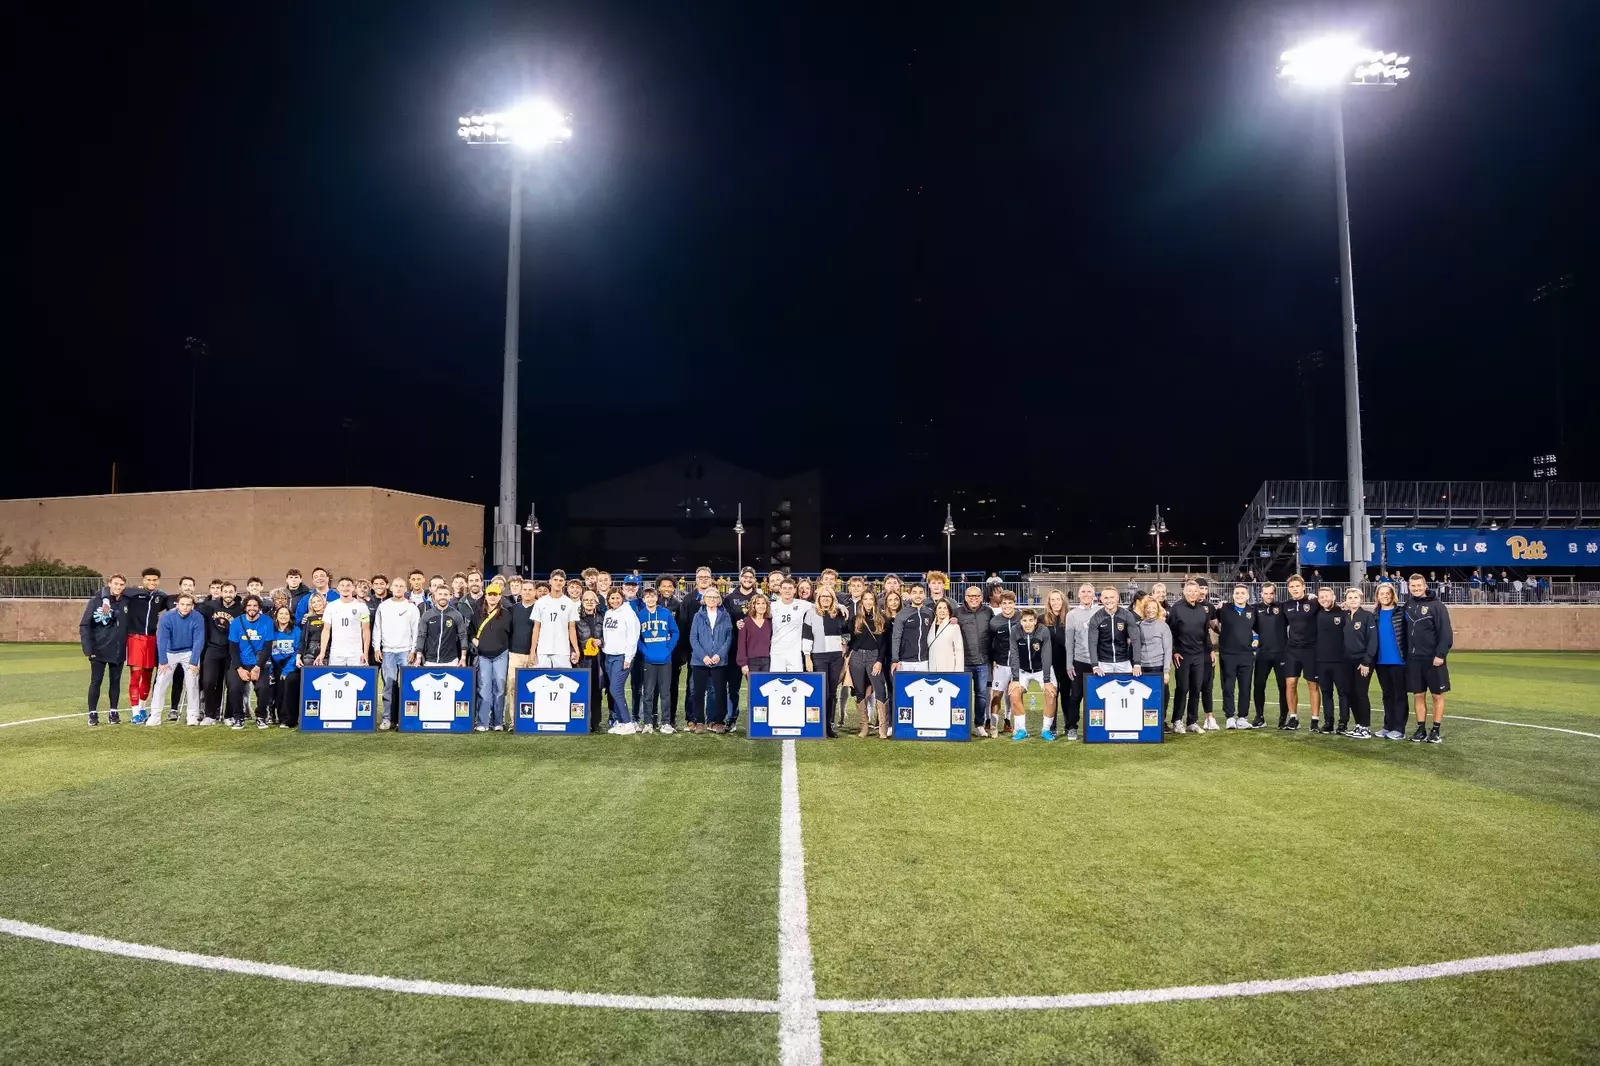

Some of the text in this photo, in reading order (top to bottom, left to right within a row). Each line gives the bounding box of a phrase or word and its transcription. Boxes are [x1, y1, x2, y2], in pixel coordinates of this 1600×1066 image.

[415, 513, 451, 549] Pitt
[1506, 535, 1547, 559] Pitt
[341, 617, 349, 627] 10
[549, 612, 558, 622] 17
[781, 614, 791, 623] 26
[641, 620, 668, 632] PITT
[334, 690, 343, 699] 10
[433, 691, 442, 701] 12
[549, 691, 558, 701] 17
[781, 696, 791, 706] 26
[929, 696, 935, 706] 8
[1120, 698, 1128, 709] 11
